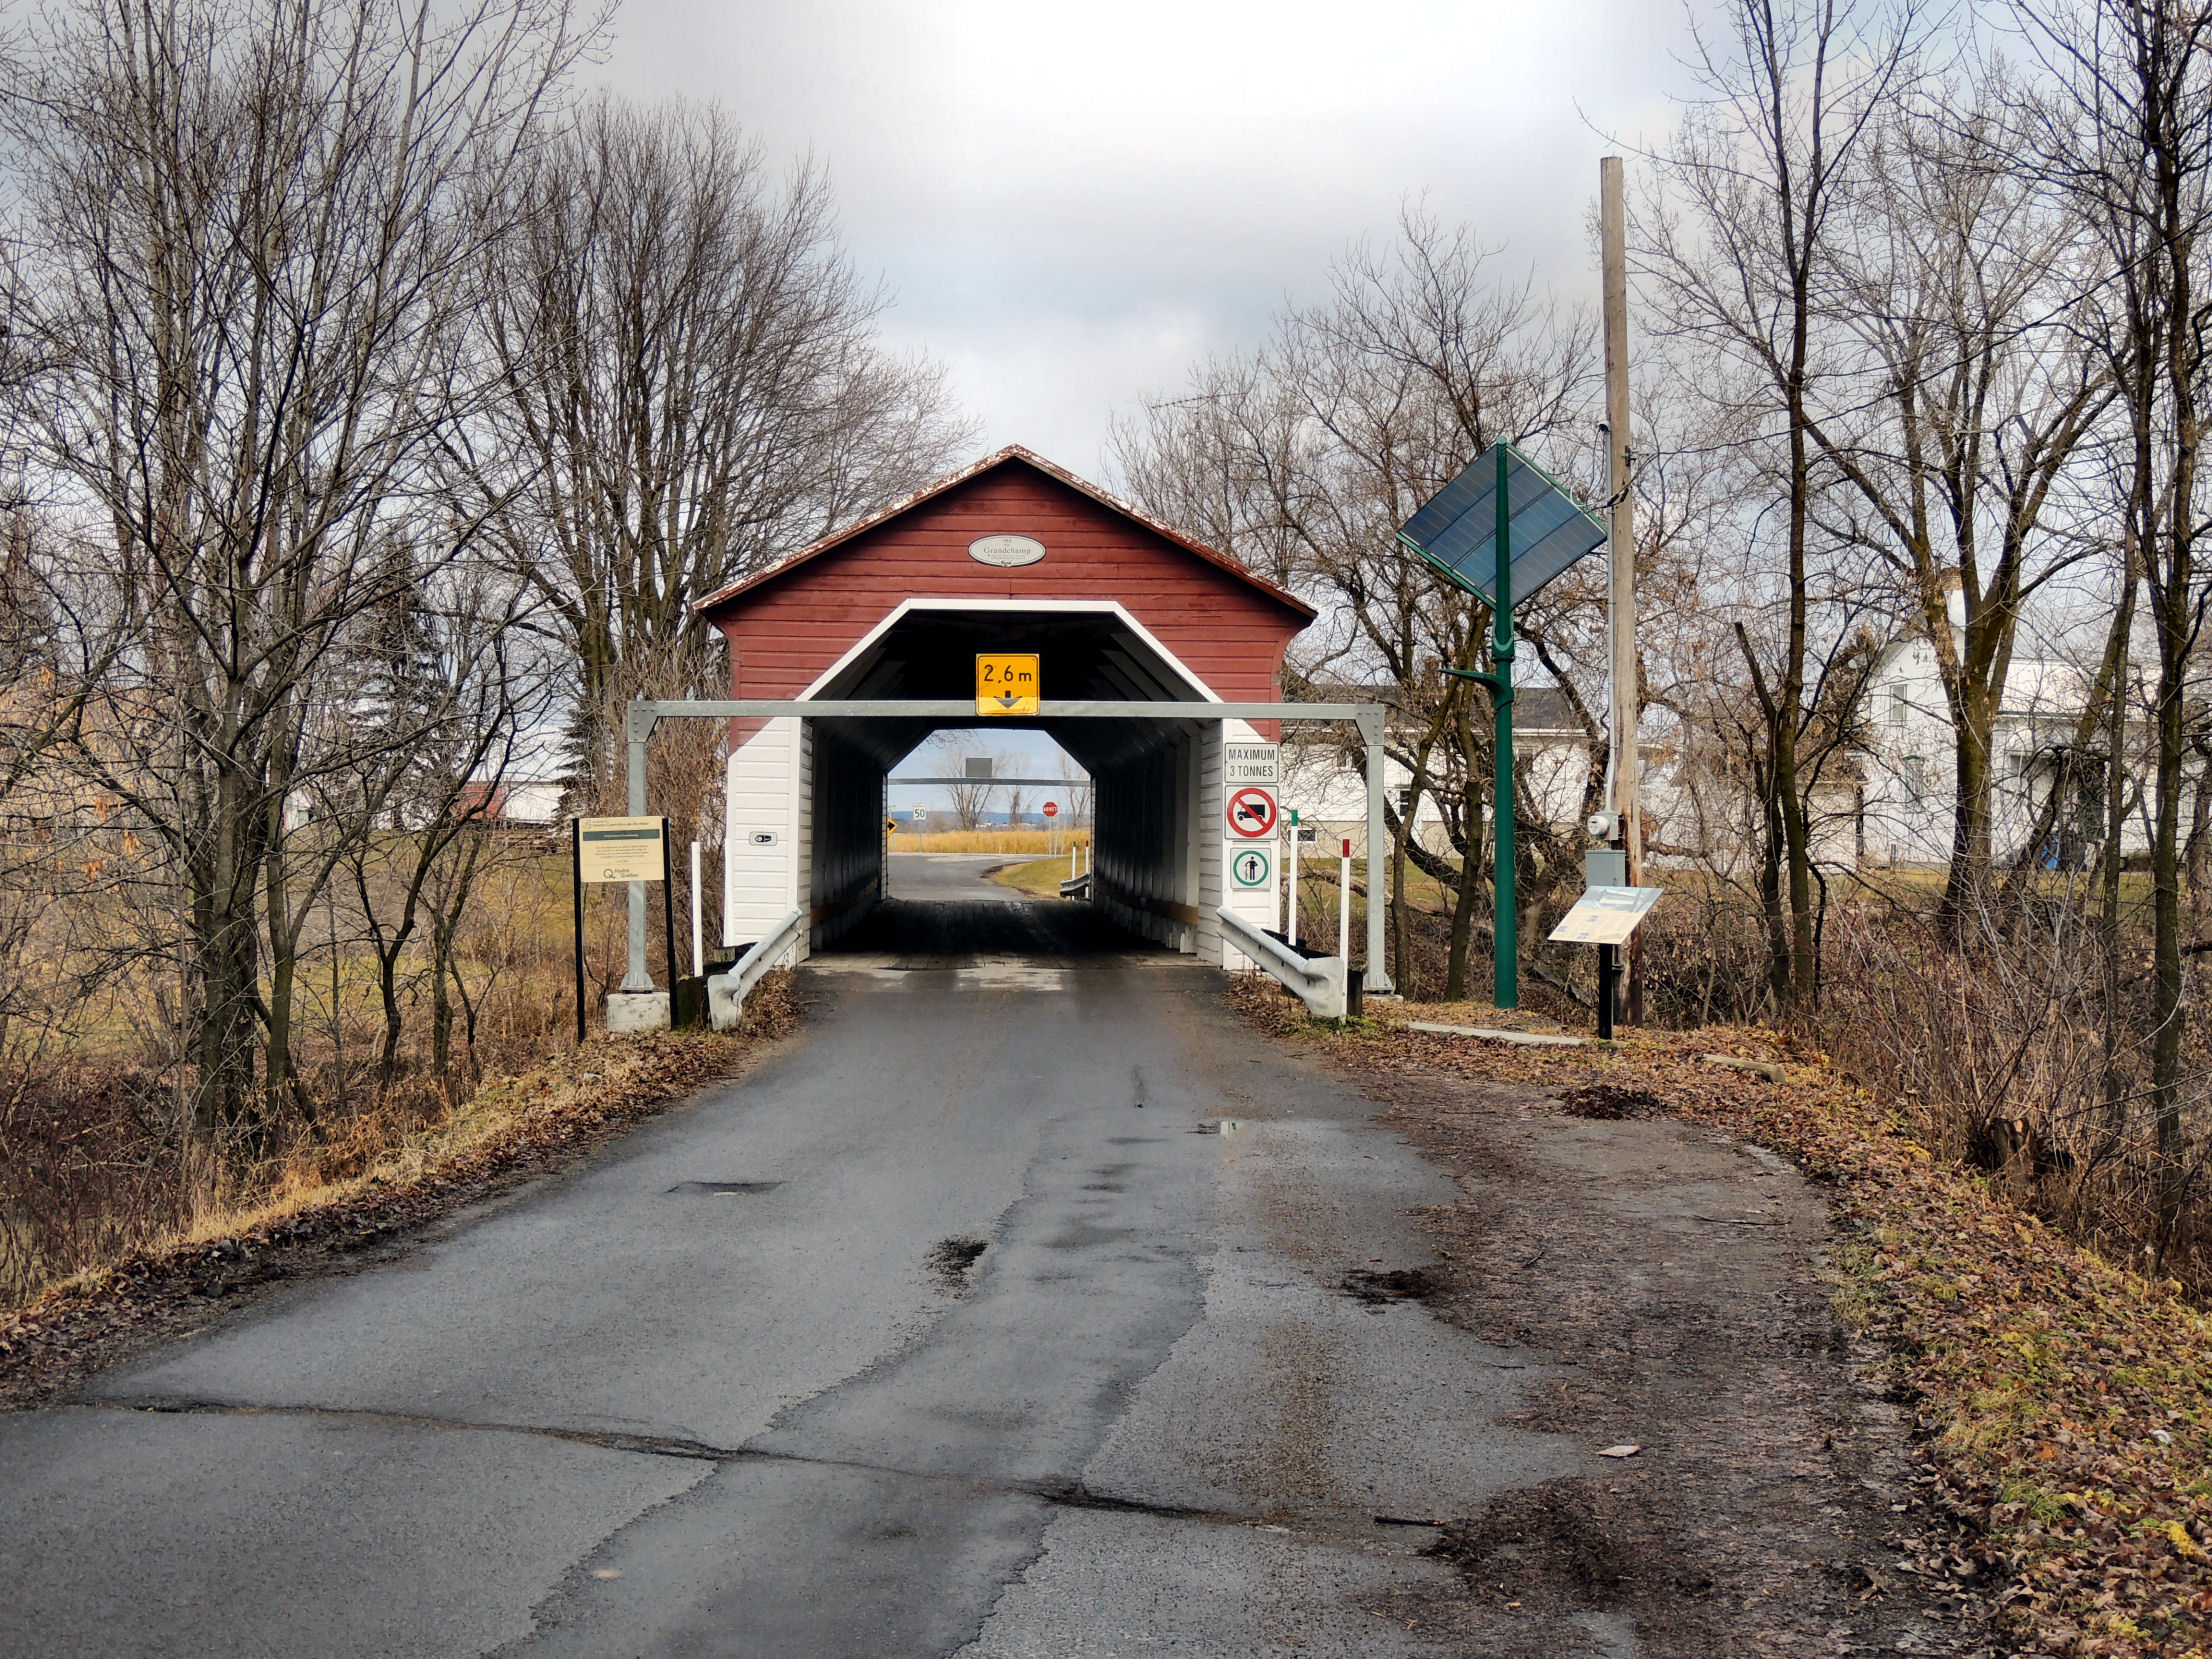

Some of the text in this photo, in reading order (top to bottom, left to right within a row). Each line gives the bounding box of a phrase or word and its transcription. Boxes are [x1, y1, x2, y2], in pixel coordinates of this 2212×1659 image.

[983, 546, 1031, 555] Grandchamp
[984, 664, 1032, 684] 2,6 m
[1228, 749, 1275, 760] MAXIMUM
[1229, 765, 1274, 777] 3 TONNES
[914, 808, 925, 818] 50
